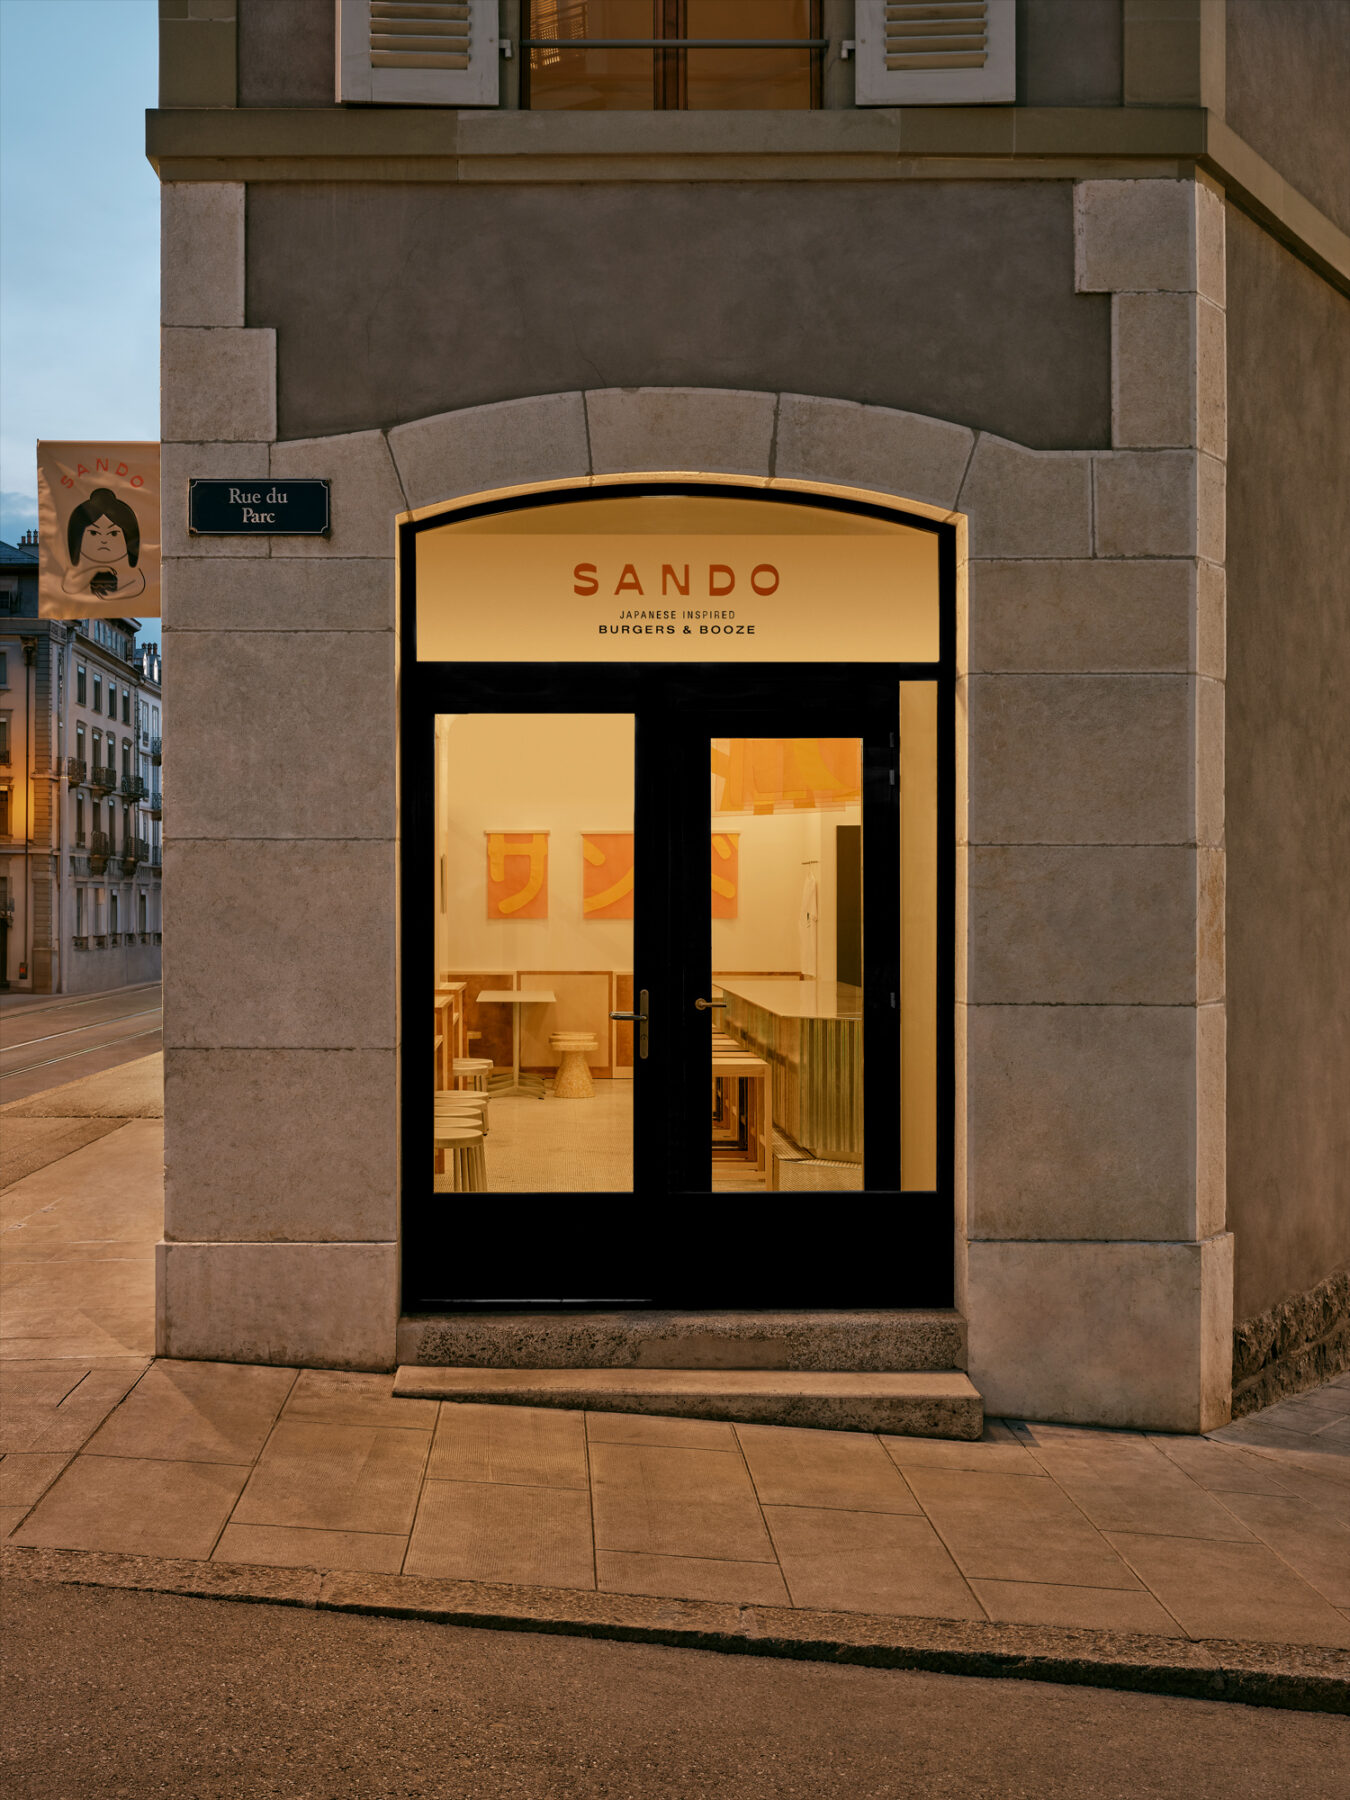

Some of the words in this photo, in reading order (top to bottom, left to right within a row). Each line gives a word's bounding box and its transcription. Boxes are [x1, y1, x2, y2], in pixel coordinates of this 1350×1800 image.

[61, 458, 144, 489] SANDO
[229, 487, 262, 504] Rue
[266, 486, 288, 504] du
[242, 507, 276, 523] Parc
[573, 562, 780, 597] SANDO
[619, 610, 677, 620] JAPANESE
[682, 610, 735, 620] INSPIRED
[598, 625, 676, 635] BURGERS
[682, 625, 692, 635] &
[699, 625, 756, 635] BOOZE
